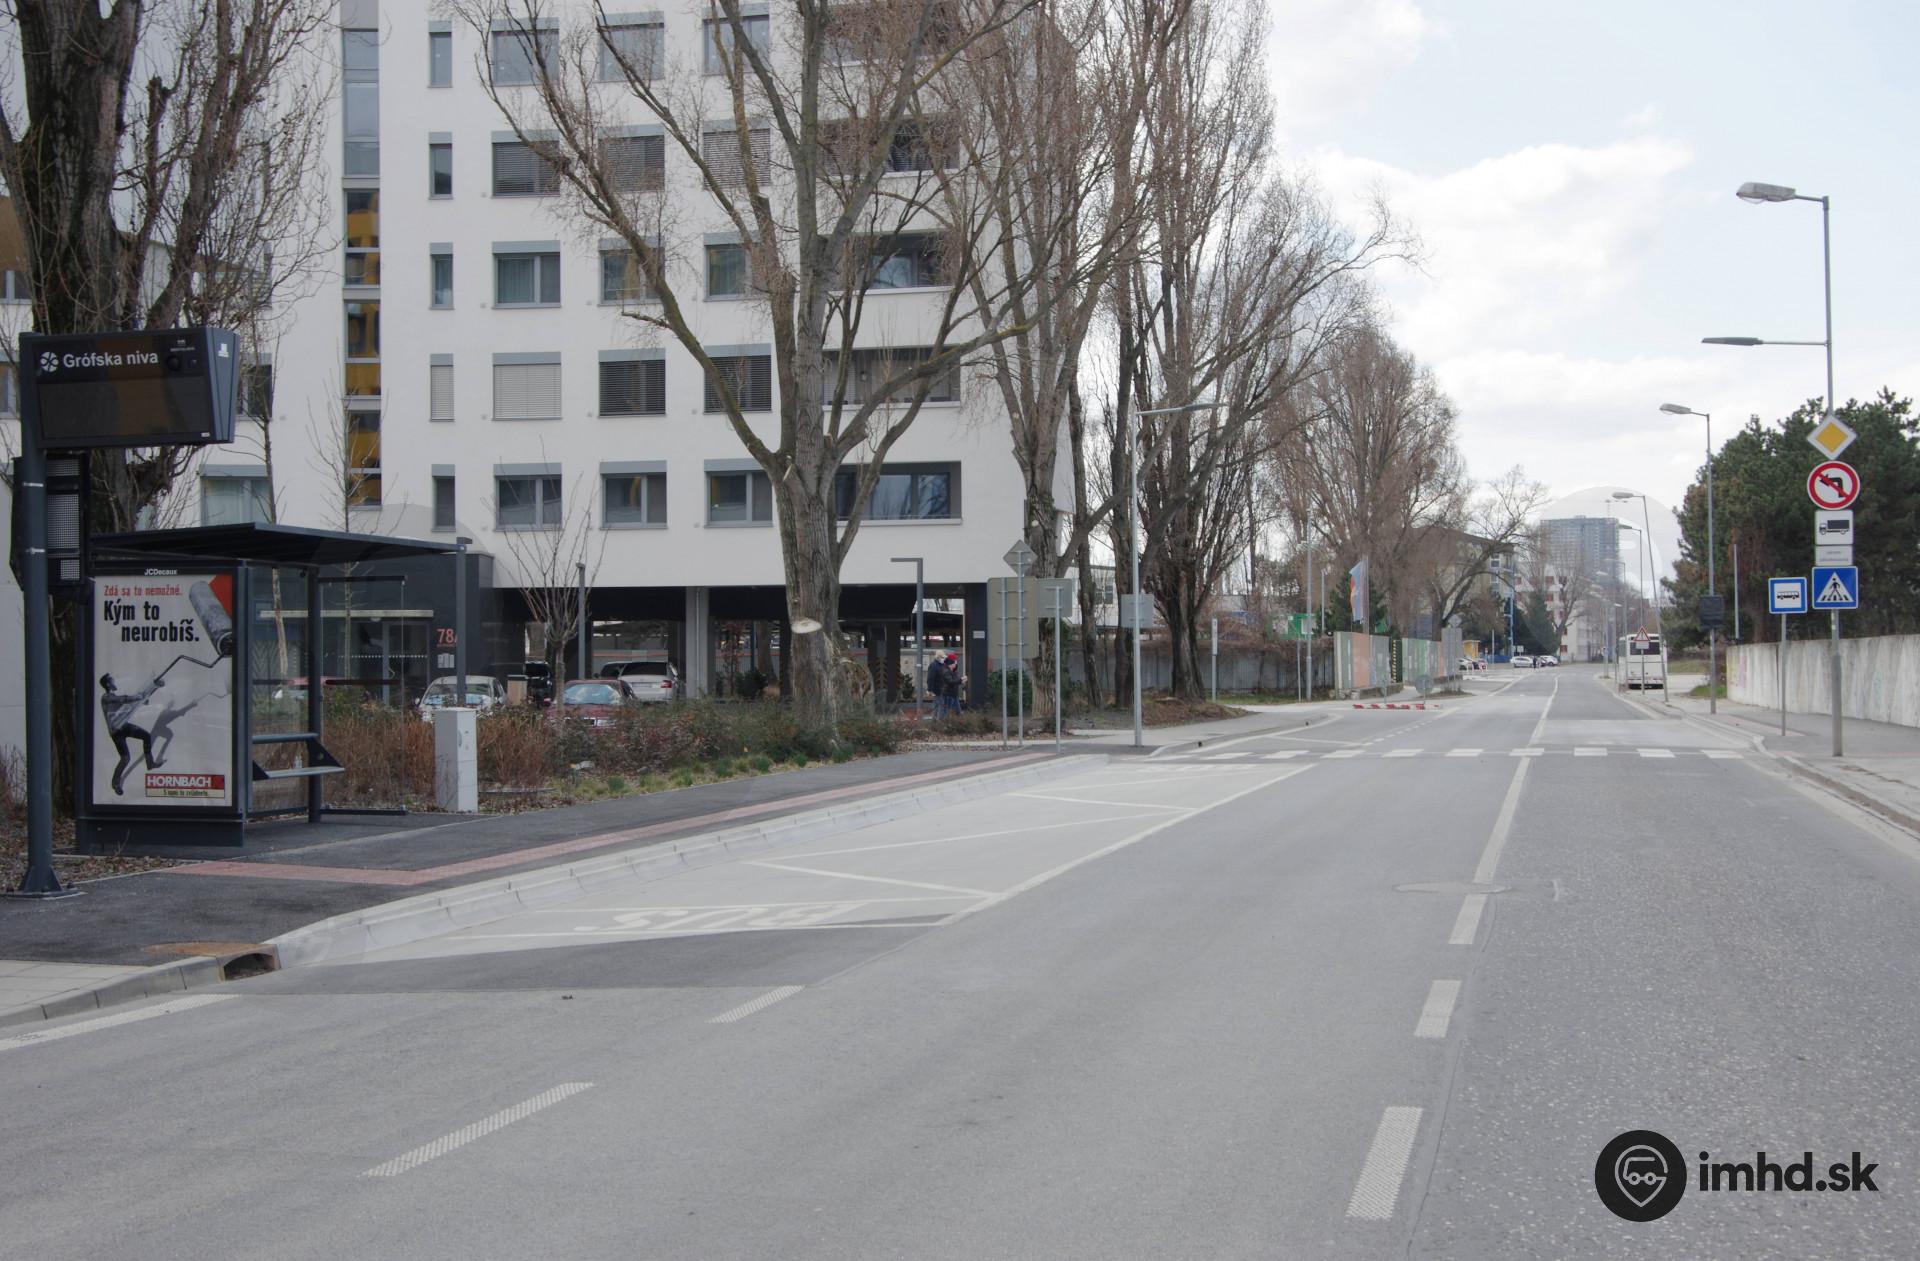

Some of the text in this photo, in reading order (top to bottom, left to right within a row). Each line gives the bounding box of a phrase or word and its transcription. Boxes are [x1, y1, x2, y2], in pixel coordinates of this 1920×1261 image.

[63, 350, 159, 369] Grófska niva
[144, 568, 178, 576] JCDecaux
[104, 584, 119, 596] Zdá
[122, 587, 131, 596] sa
[134, 586, 142, 596] to
[104, 598, 160, 625] Kým to
[121, 619, 199, 642] neurobíš.
[147, 776, 211, 787] HORNBACH
